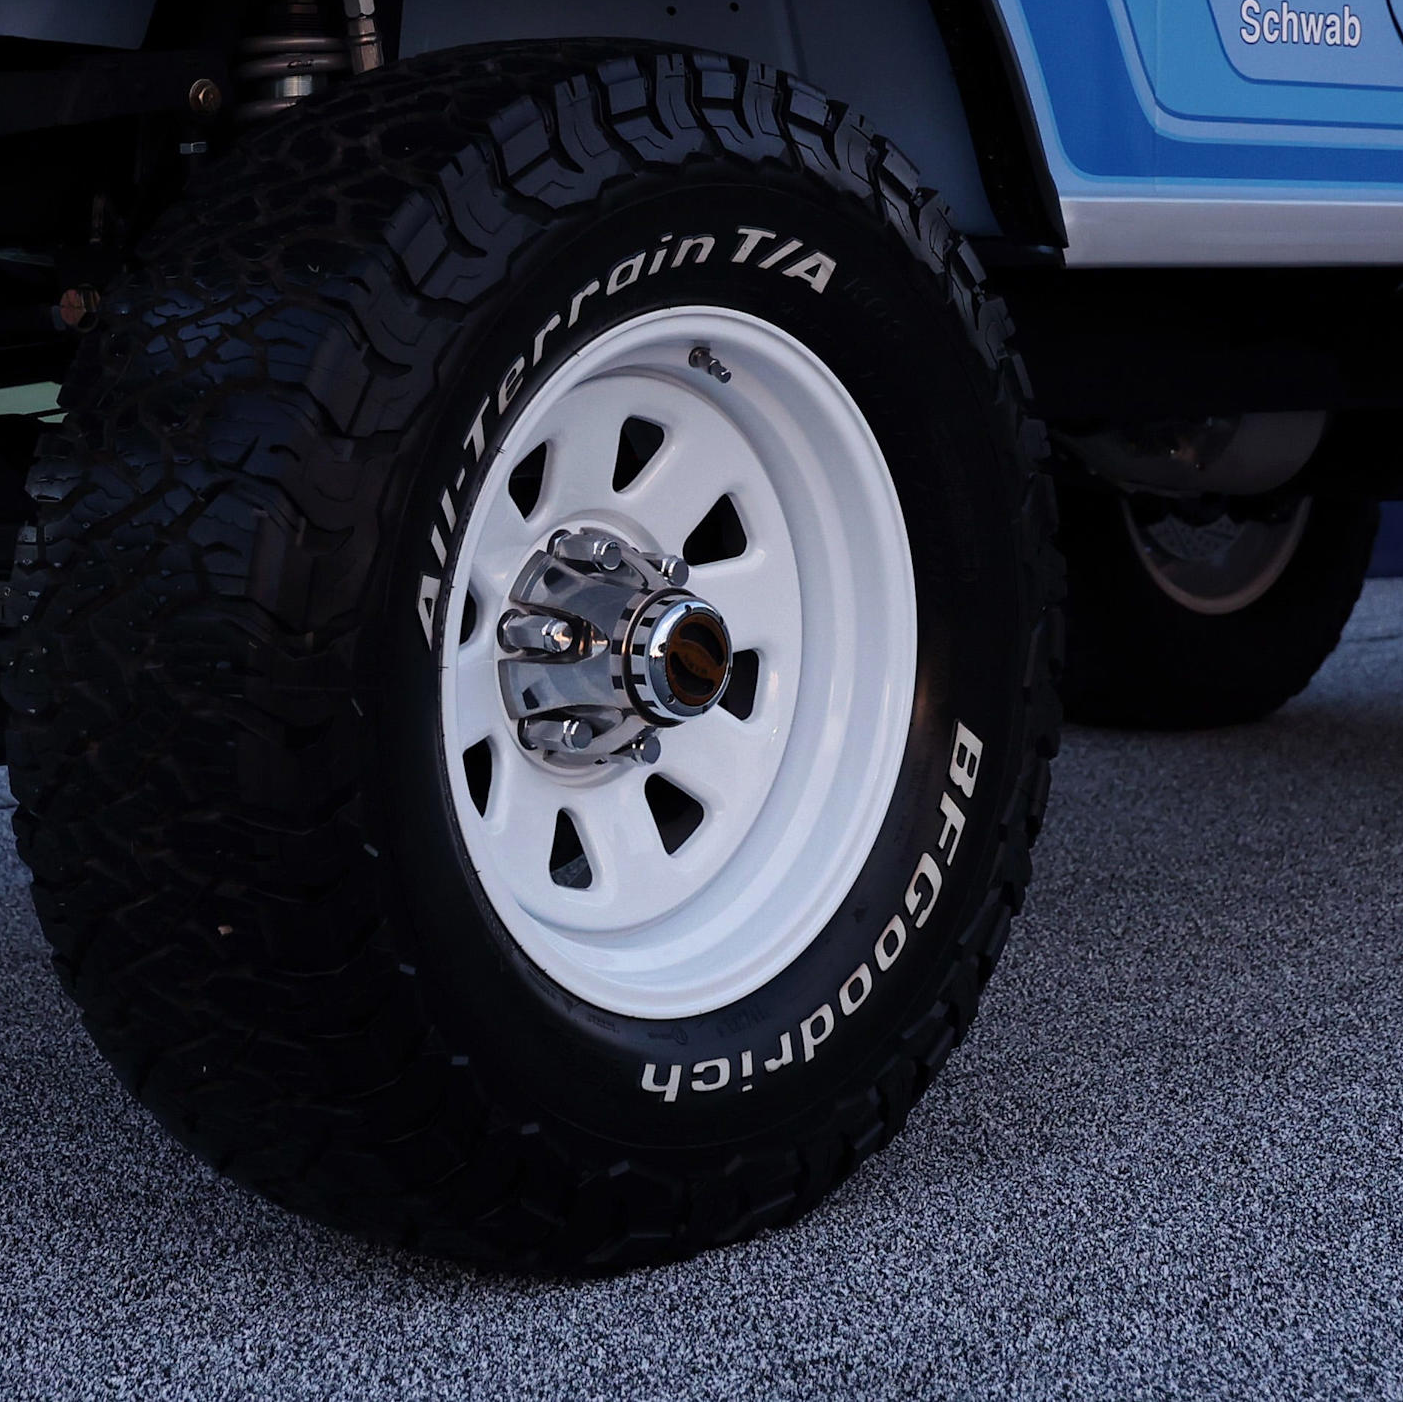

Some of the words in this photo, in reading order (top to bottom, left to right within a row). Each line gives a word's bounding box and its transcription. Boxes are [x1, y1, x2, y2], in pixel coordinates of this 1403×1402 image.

[416, 232, 716, 652] All-Terrain
[729, 226, 838, 295] T/A
[639, 721, 983, 1102] BFGoodrich
